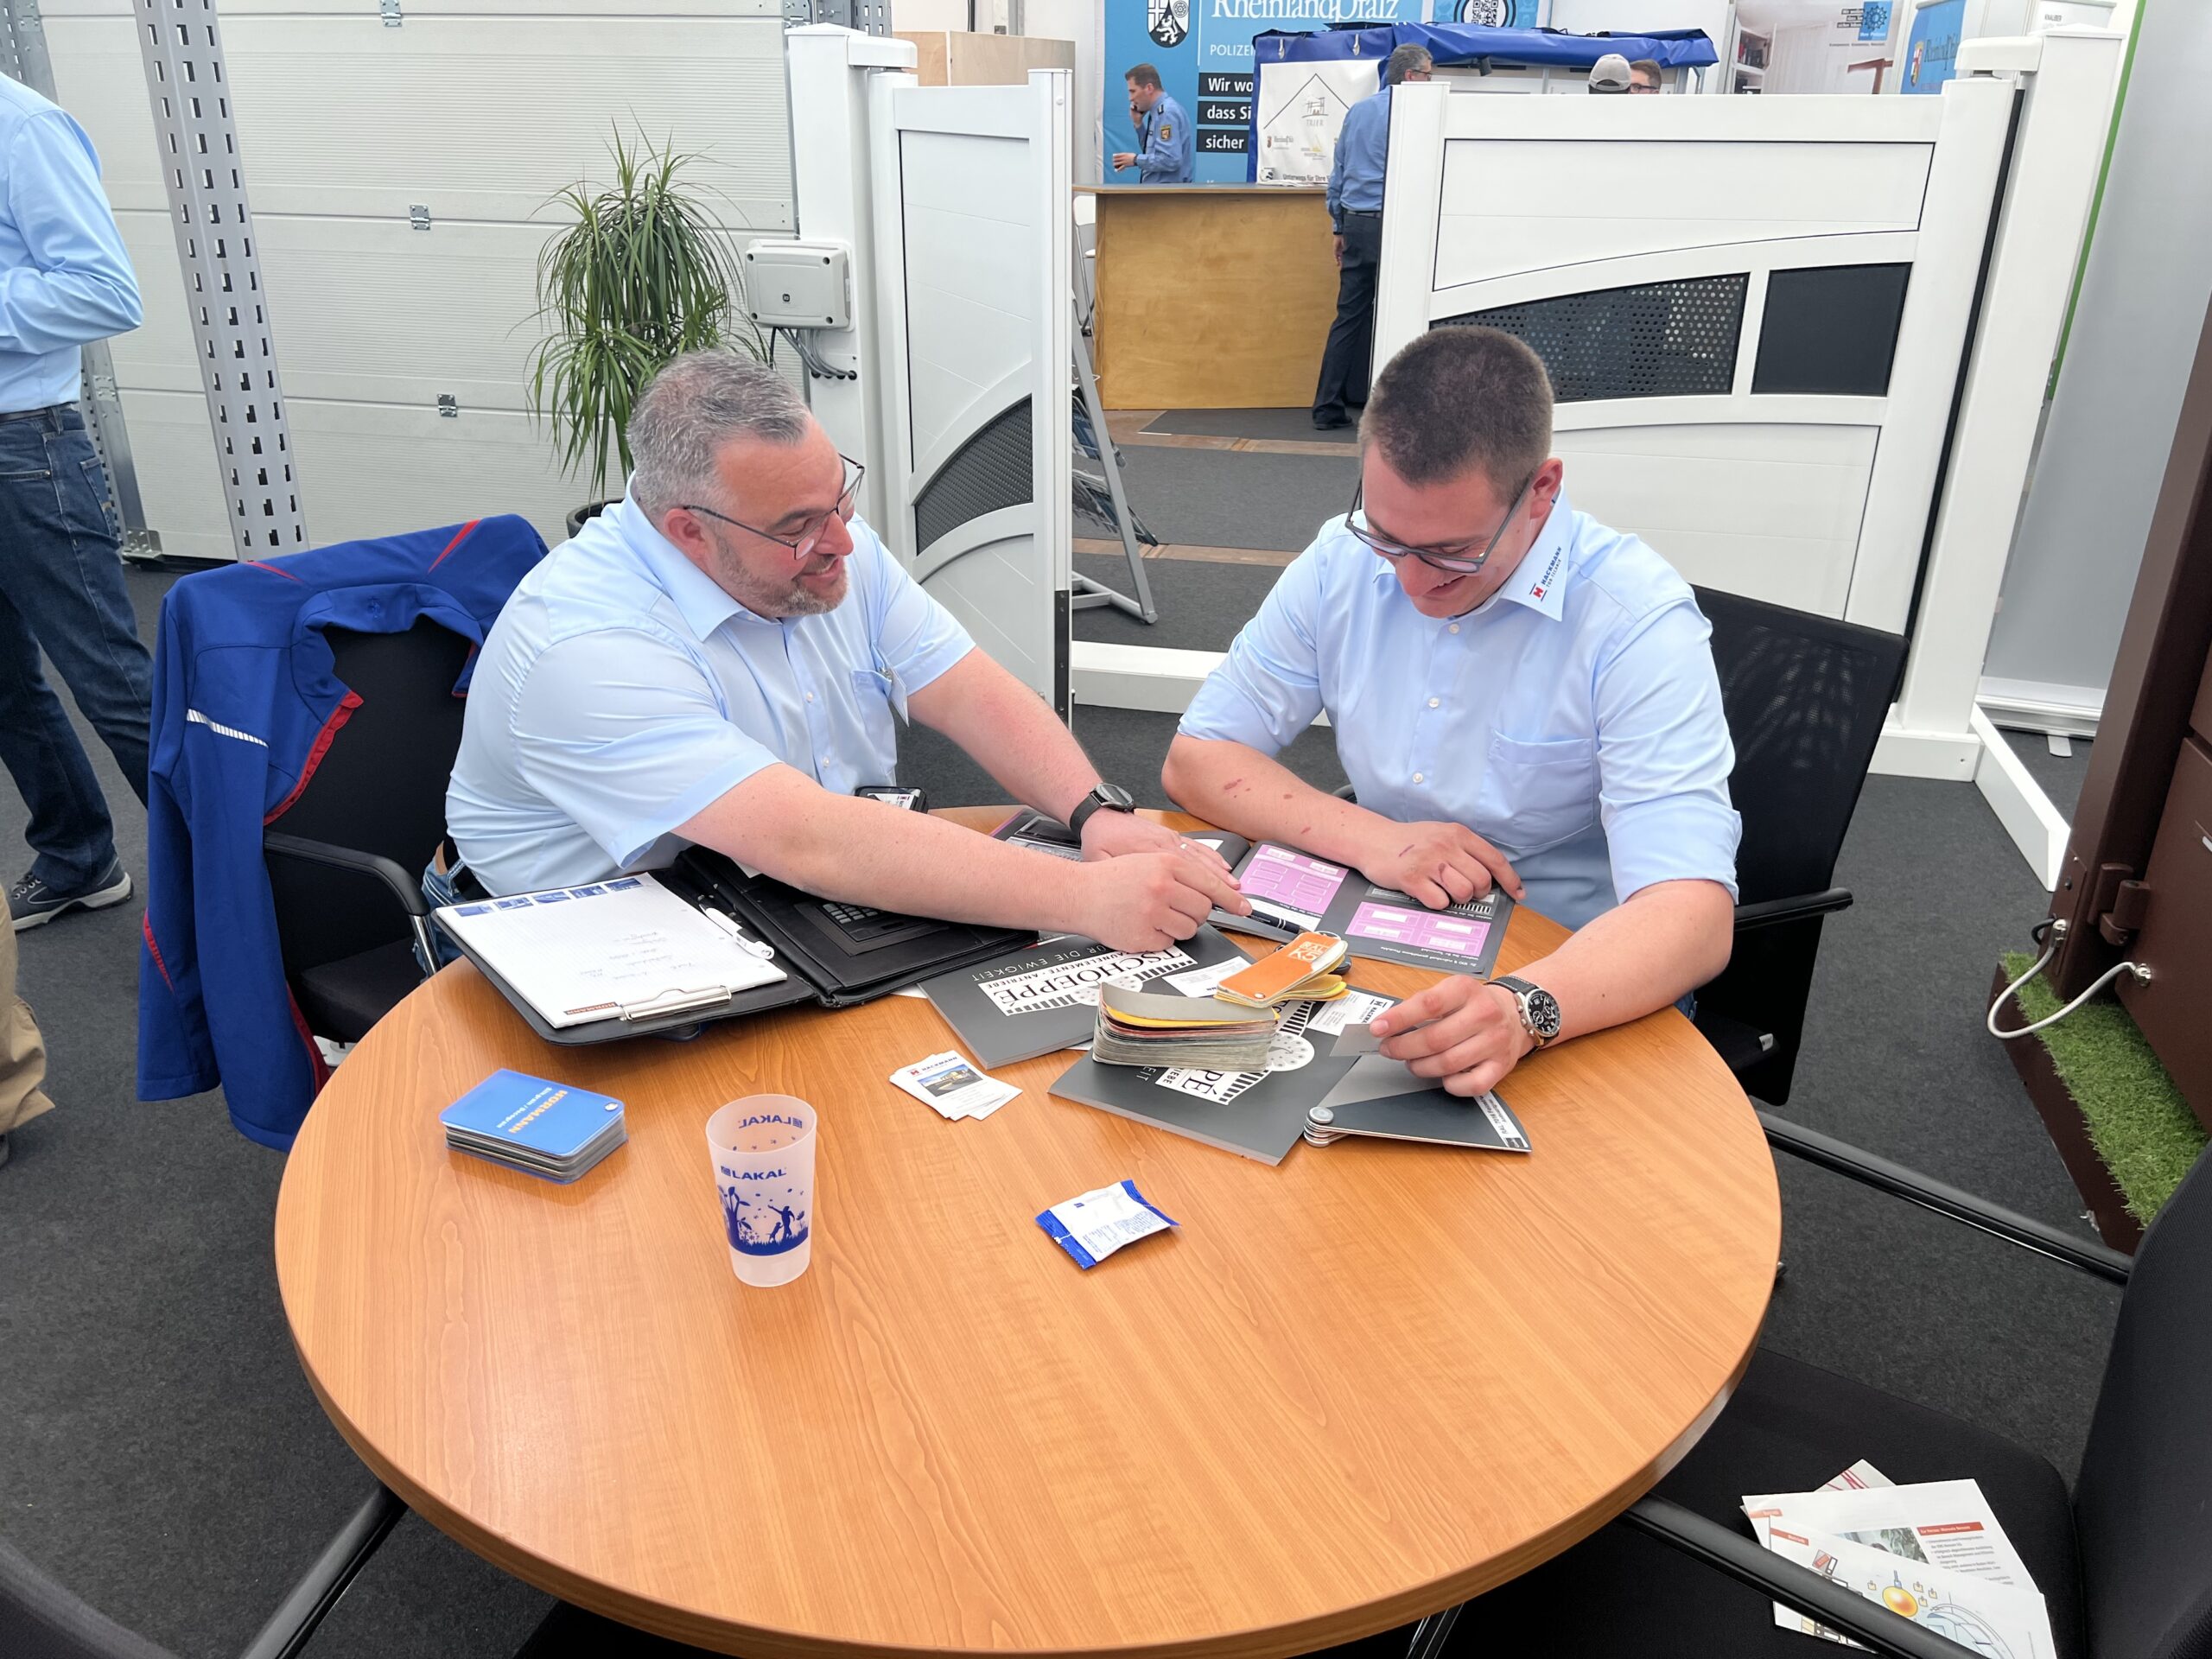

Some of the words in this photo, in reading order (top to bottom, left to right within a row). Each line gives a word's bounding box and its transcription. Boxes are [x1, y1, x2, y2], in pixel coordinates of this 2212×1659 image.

[1208, 78, 1230, 92] Wir
[1206, 105, 1236, 119] dass
[1205, 135, 1244, 149] sicher
[1541, 545, 1562, 585] HACKMANN
[1055, 950, 1080, 962] DIE
[1089, 944, 1107, 955] ÜR
[971, 958, 1047, 982] EWIGKEIT
[986, 972, 1039, 989] ANTRIEBE
[732, 1169, 787, 1180] LAKAL
